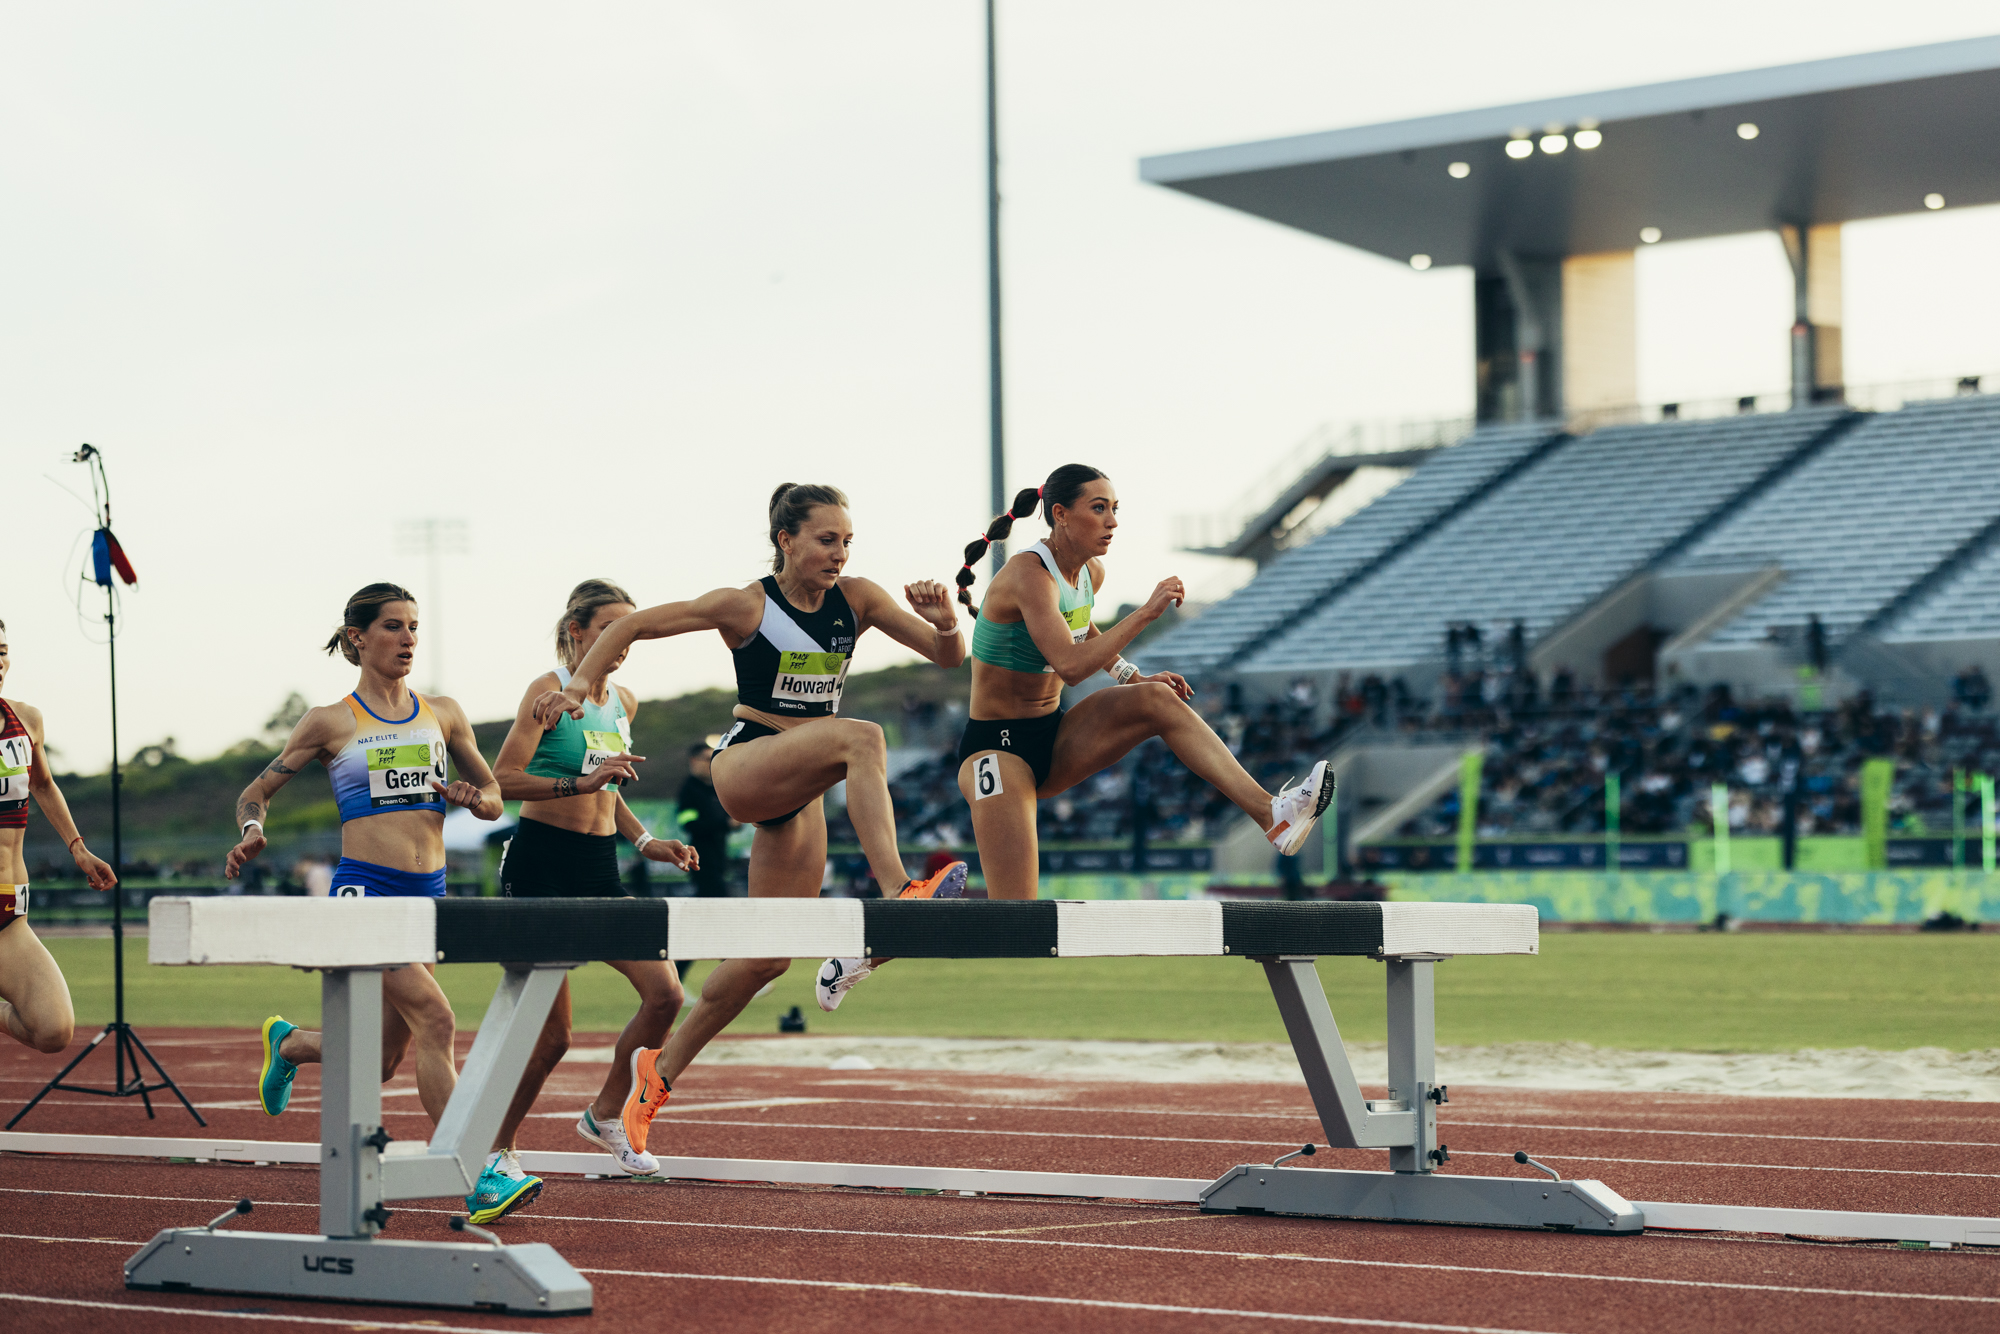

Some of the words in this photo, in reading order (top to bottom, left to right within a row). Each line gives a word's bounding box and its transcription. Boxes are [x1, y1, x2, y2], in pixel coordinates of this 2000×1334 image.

[790, 652, 810, 661] TRACK
[789, 661, 807, 670] FEST
[780, 676, 836, 694] Howard
[779, 701, 798, 709] Dream
[357, 736, 374, 745] NAZ
[375, 733, 399, 742] ELITE
[375, 747, 397, 758] TRACK
[378, 755, 397, 767] FEST
[434, 741, 445, 778] 8
[385, 768, 429, 790] Gear
[979, 757, 995, 796] 6
[379, 798, 398, 806] Dream
[476, 1192, 500, 1205] HOKA
[303, 1254, 355, 1275] UCS
